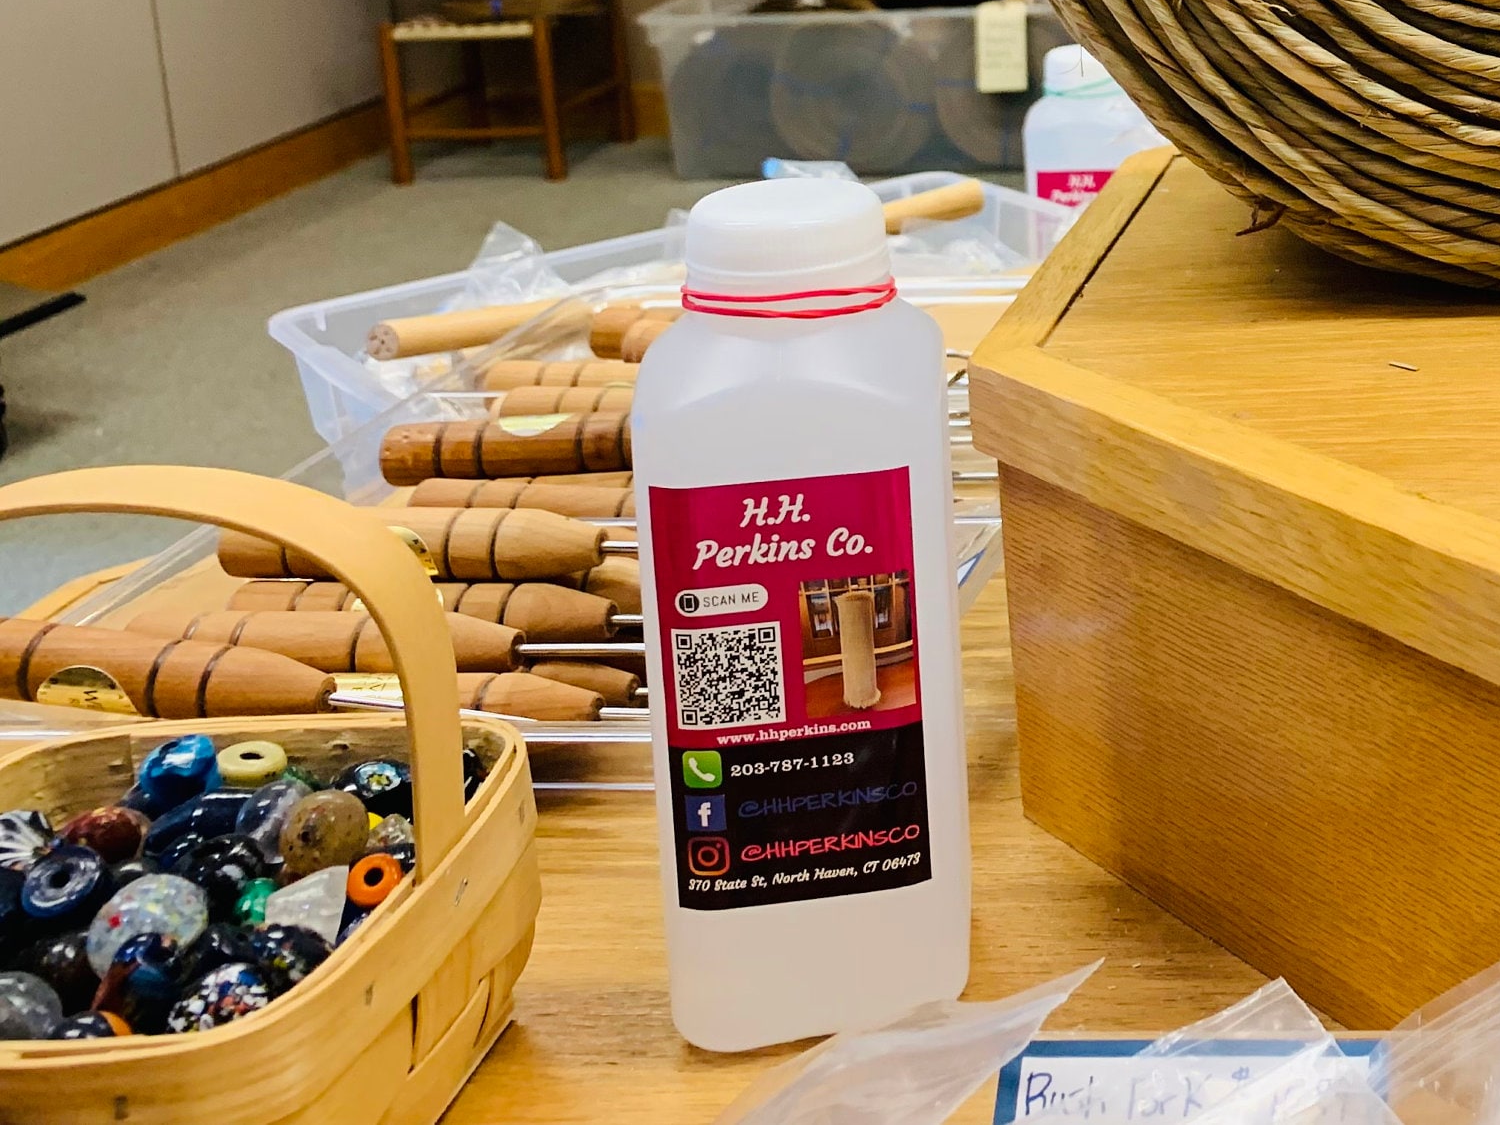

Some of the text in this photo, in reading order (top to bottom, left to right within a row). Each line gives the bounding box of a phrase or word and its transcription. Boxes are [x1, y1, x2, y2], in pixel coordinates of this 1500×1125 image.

[739, 493, 811, 528] H.H.
[692, 527, 873, 570] Perkins Co.
[703, 591, 760, 607] SCAN ME
[716, 719, 872, 745] www.hhperkins.com
[730, 752, 855, 777] 203-787-1123
[737, 781, 917, 818] @HHPERKINSCO
[740, 824, 920, 862] @HHPERKINSCO
[688, 878, 711, 892] 370
[714, 878, 747, 892] State
[750, 874, 768, 889] St,
[772, 869, 810, 885] North
[814, 865, 858, 882] Haven,
[862, 861, 879, 874] CT
